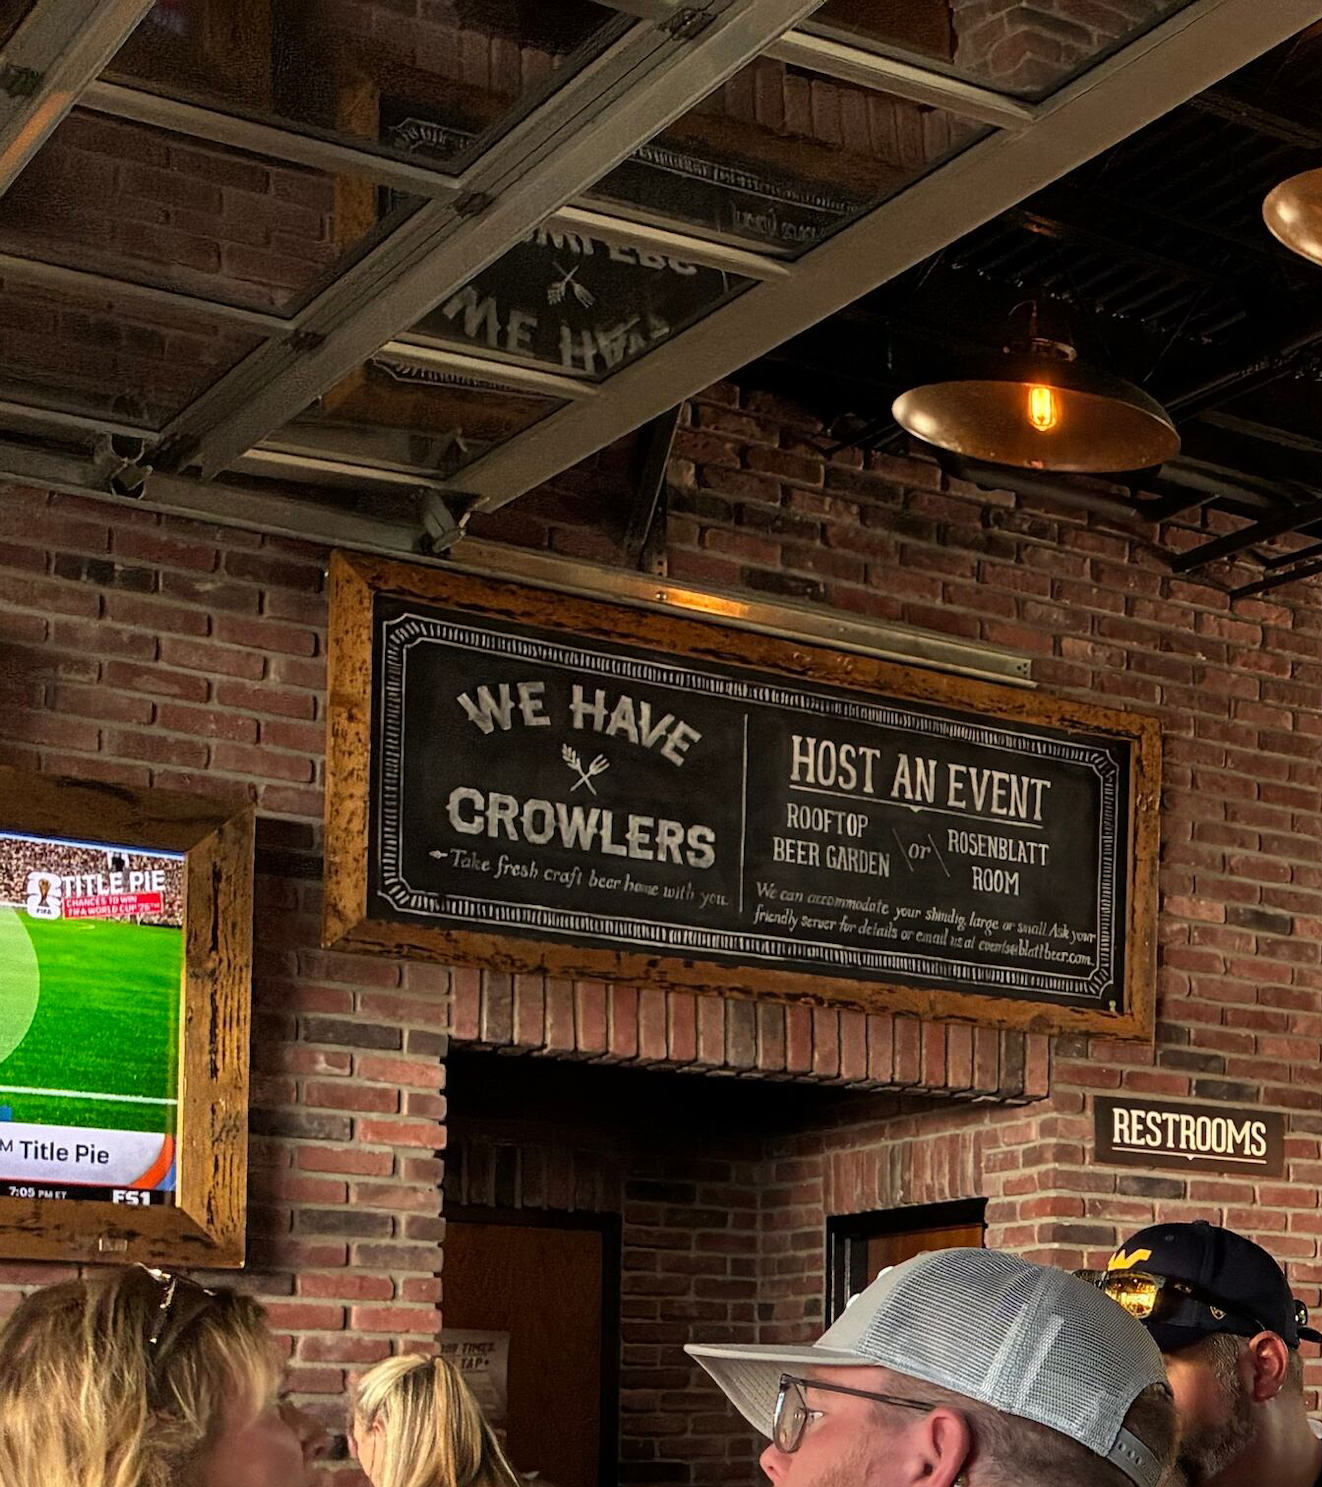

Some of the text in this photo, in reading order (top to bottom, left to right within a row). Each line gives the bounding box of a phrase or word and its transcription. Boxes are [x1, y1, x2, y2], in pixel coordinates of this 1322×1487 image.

[456, 681, 702, 767] WE HAVE
[790, 735, 1052, 822] HOST AN EVENT
[446, 786, 716, 869] CROWLERS
[786, 803, 869, 838] ROOFTOP
[772, 836, 891, 878] BEER GARDEN
[908, 842, 931, 860] or
[948, 829, 1050, 866] ROSENBLATT
[61, 870, 167, 899] TITLE PIE
[451, 849, 491, 872] Take
[494, 854, 538, 879] fresh
[544, 866, 583, 889] craft
[589, 870, 622, 890] beer
[624, 874, 660, 897] home
[664, 883, 695, 899] with
[972, 866, 1021, 896] ROOM
[753, 903, 799, 932] friendly
[801, 914, 837, 931] server
[838, 914, 857, 932] for
[858, 918, 898, 940] details
[901, 929, 915, 941] or
[915, 928, 949, 946] email
[756, 881, 777, 900] We
[780, 889, 804, 902] can
[893, 905, 922, 921] your
[969, 911, 1000, 936] large
[1002, 920, 1015, 932] or
[1049, 922, 1070, 940] Ask
[1070, 930, 1097, 945] your
[1111, 1107, 1267, 1157] RESTROOMS
[20, 1140, 69, 1162] Title
[75, 1144, 110, 1165] Pie
[9, 1186, 36, 1199] 7:05
[38, 1189, 54, 1199] PM
[112, 1189, 152, 1206] FS1
